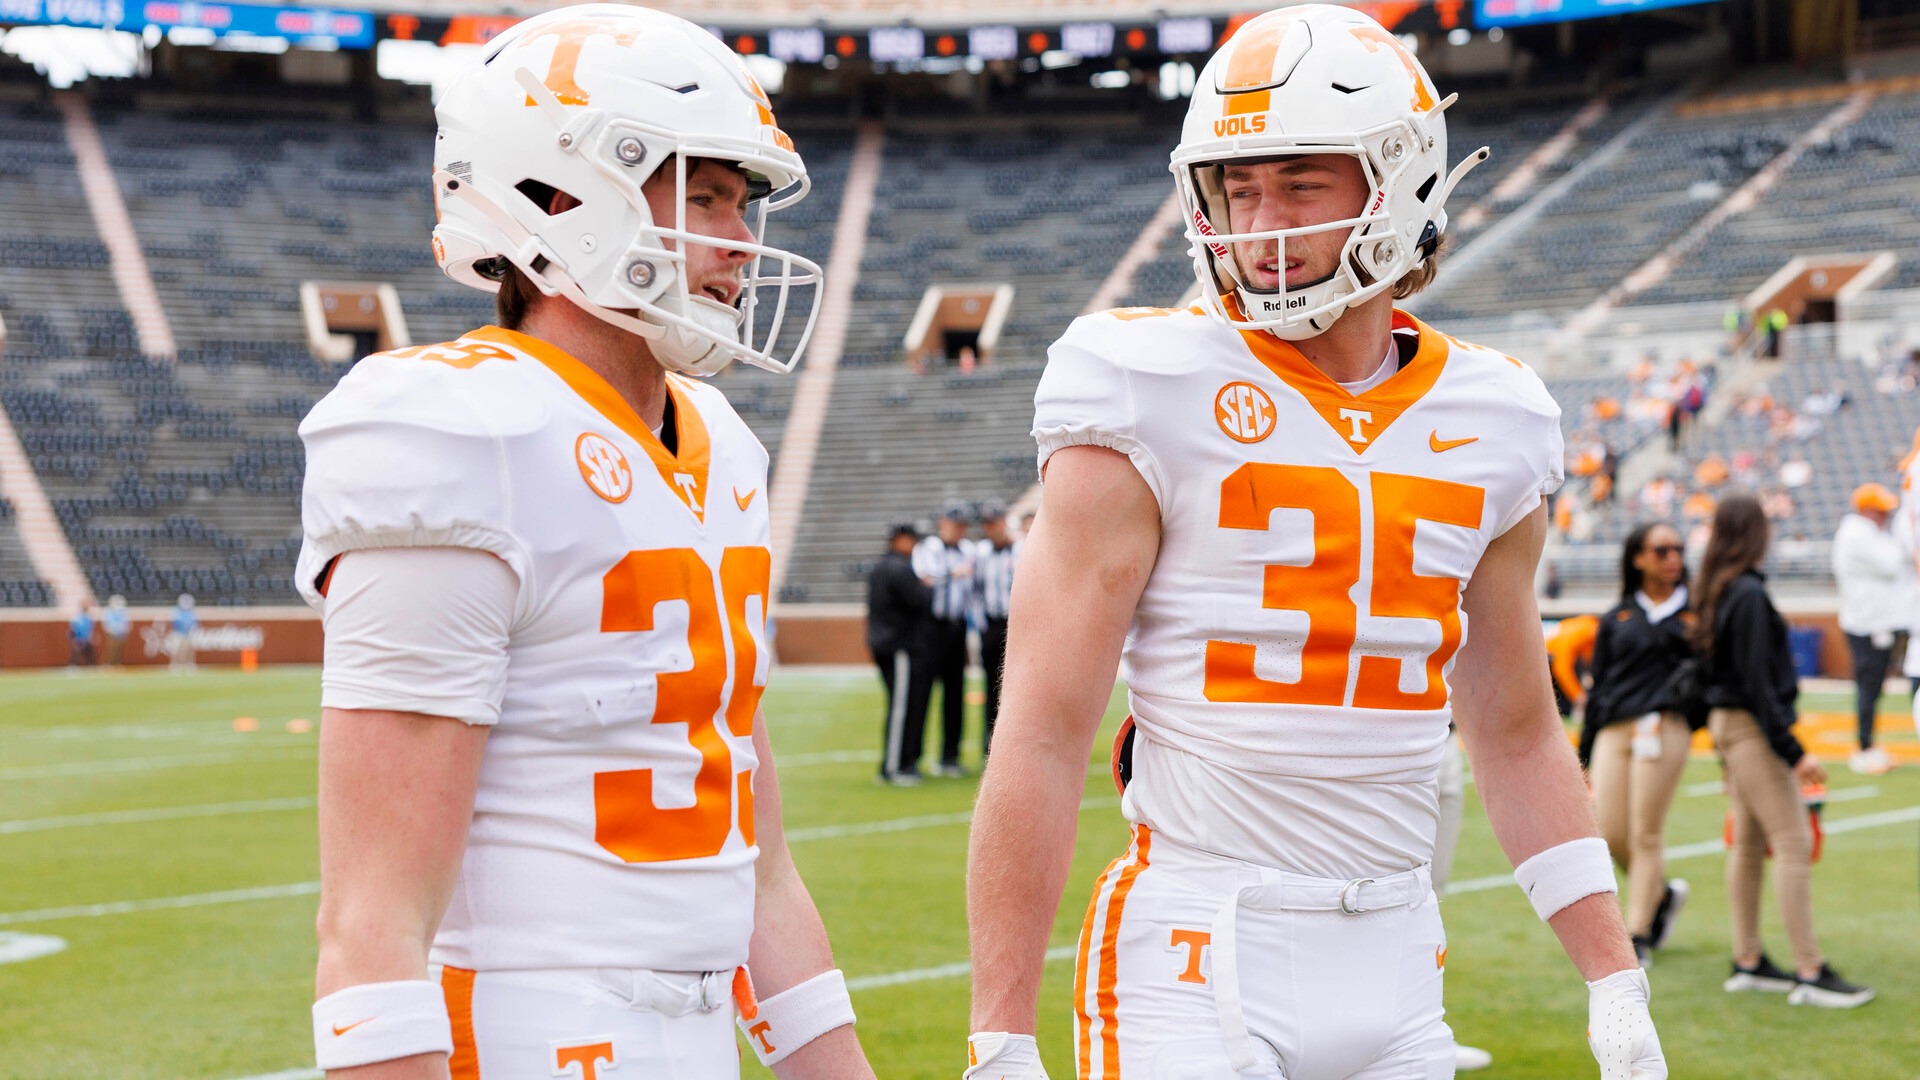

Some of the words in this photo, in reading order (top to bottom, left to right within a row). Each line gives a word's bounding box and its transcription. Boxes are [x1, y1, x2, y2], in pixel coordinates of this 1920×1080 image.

[516, 20, 640, 107] T
[1214, 115, 1266, 138] VOLS
[1219, 385, 1272, 438] SEC
[1340, 408, 1372, 442] T
[580, 436, 629, 497] SEC
[673, 472, 703, 512] T
[1203, 461, 1485, 711] 35
[594, 546, 771, 863] 39
[1171, 929, 1211, 984] T
[748, 1020, 777, 1054] T
